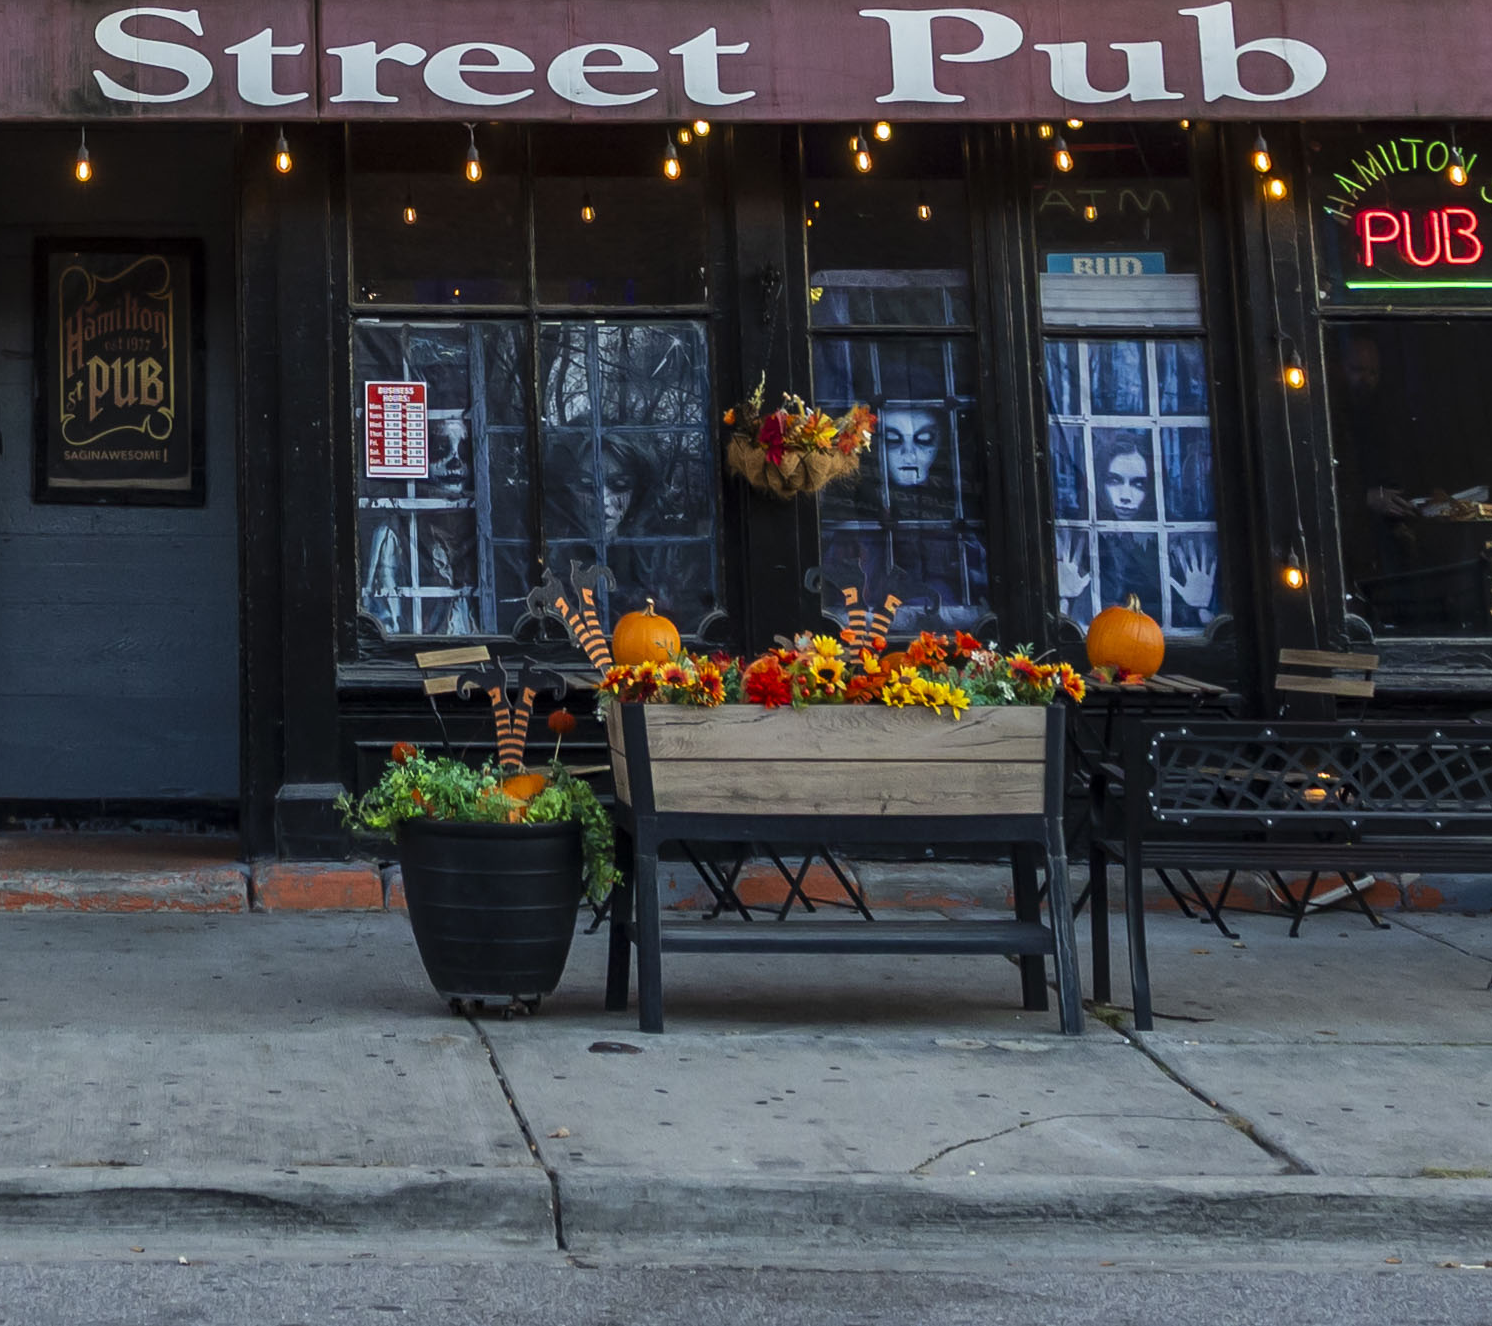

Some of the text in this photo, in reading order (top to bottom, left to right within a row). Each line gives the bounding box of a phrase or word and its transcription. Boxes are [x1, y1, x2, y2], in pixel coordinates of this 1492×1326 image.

[92, 5, 757, 108] Street
[857, 1, 1329, 106] Pub
[1038, 188, 1172, 213] ATM
[1361, 208, 1484, 267] PUB
[65, 291, 168, 379] Hamilton
[86, 355, 165, 422] PUB
